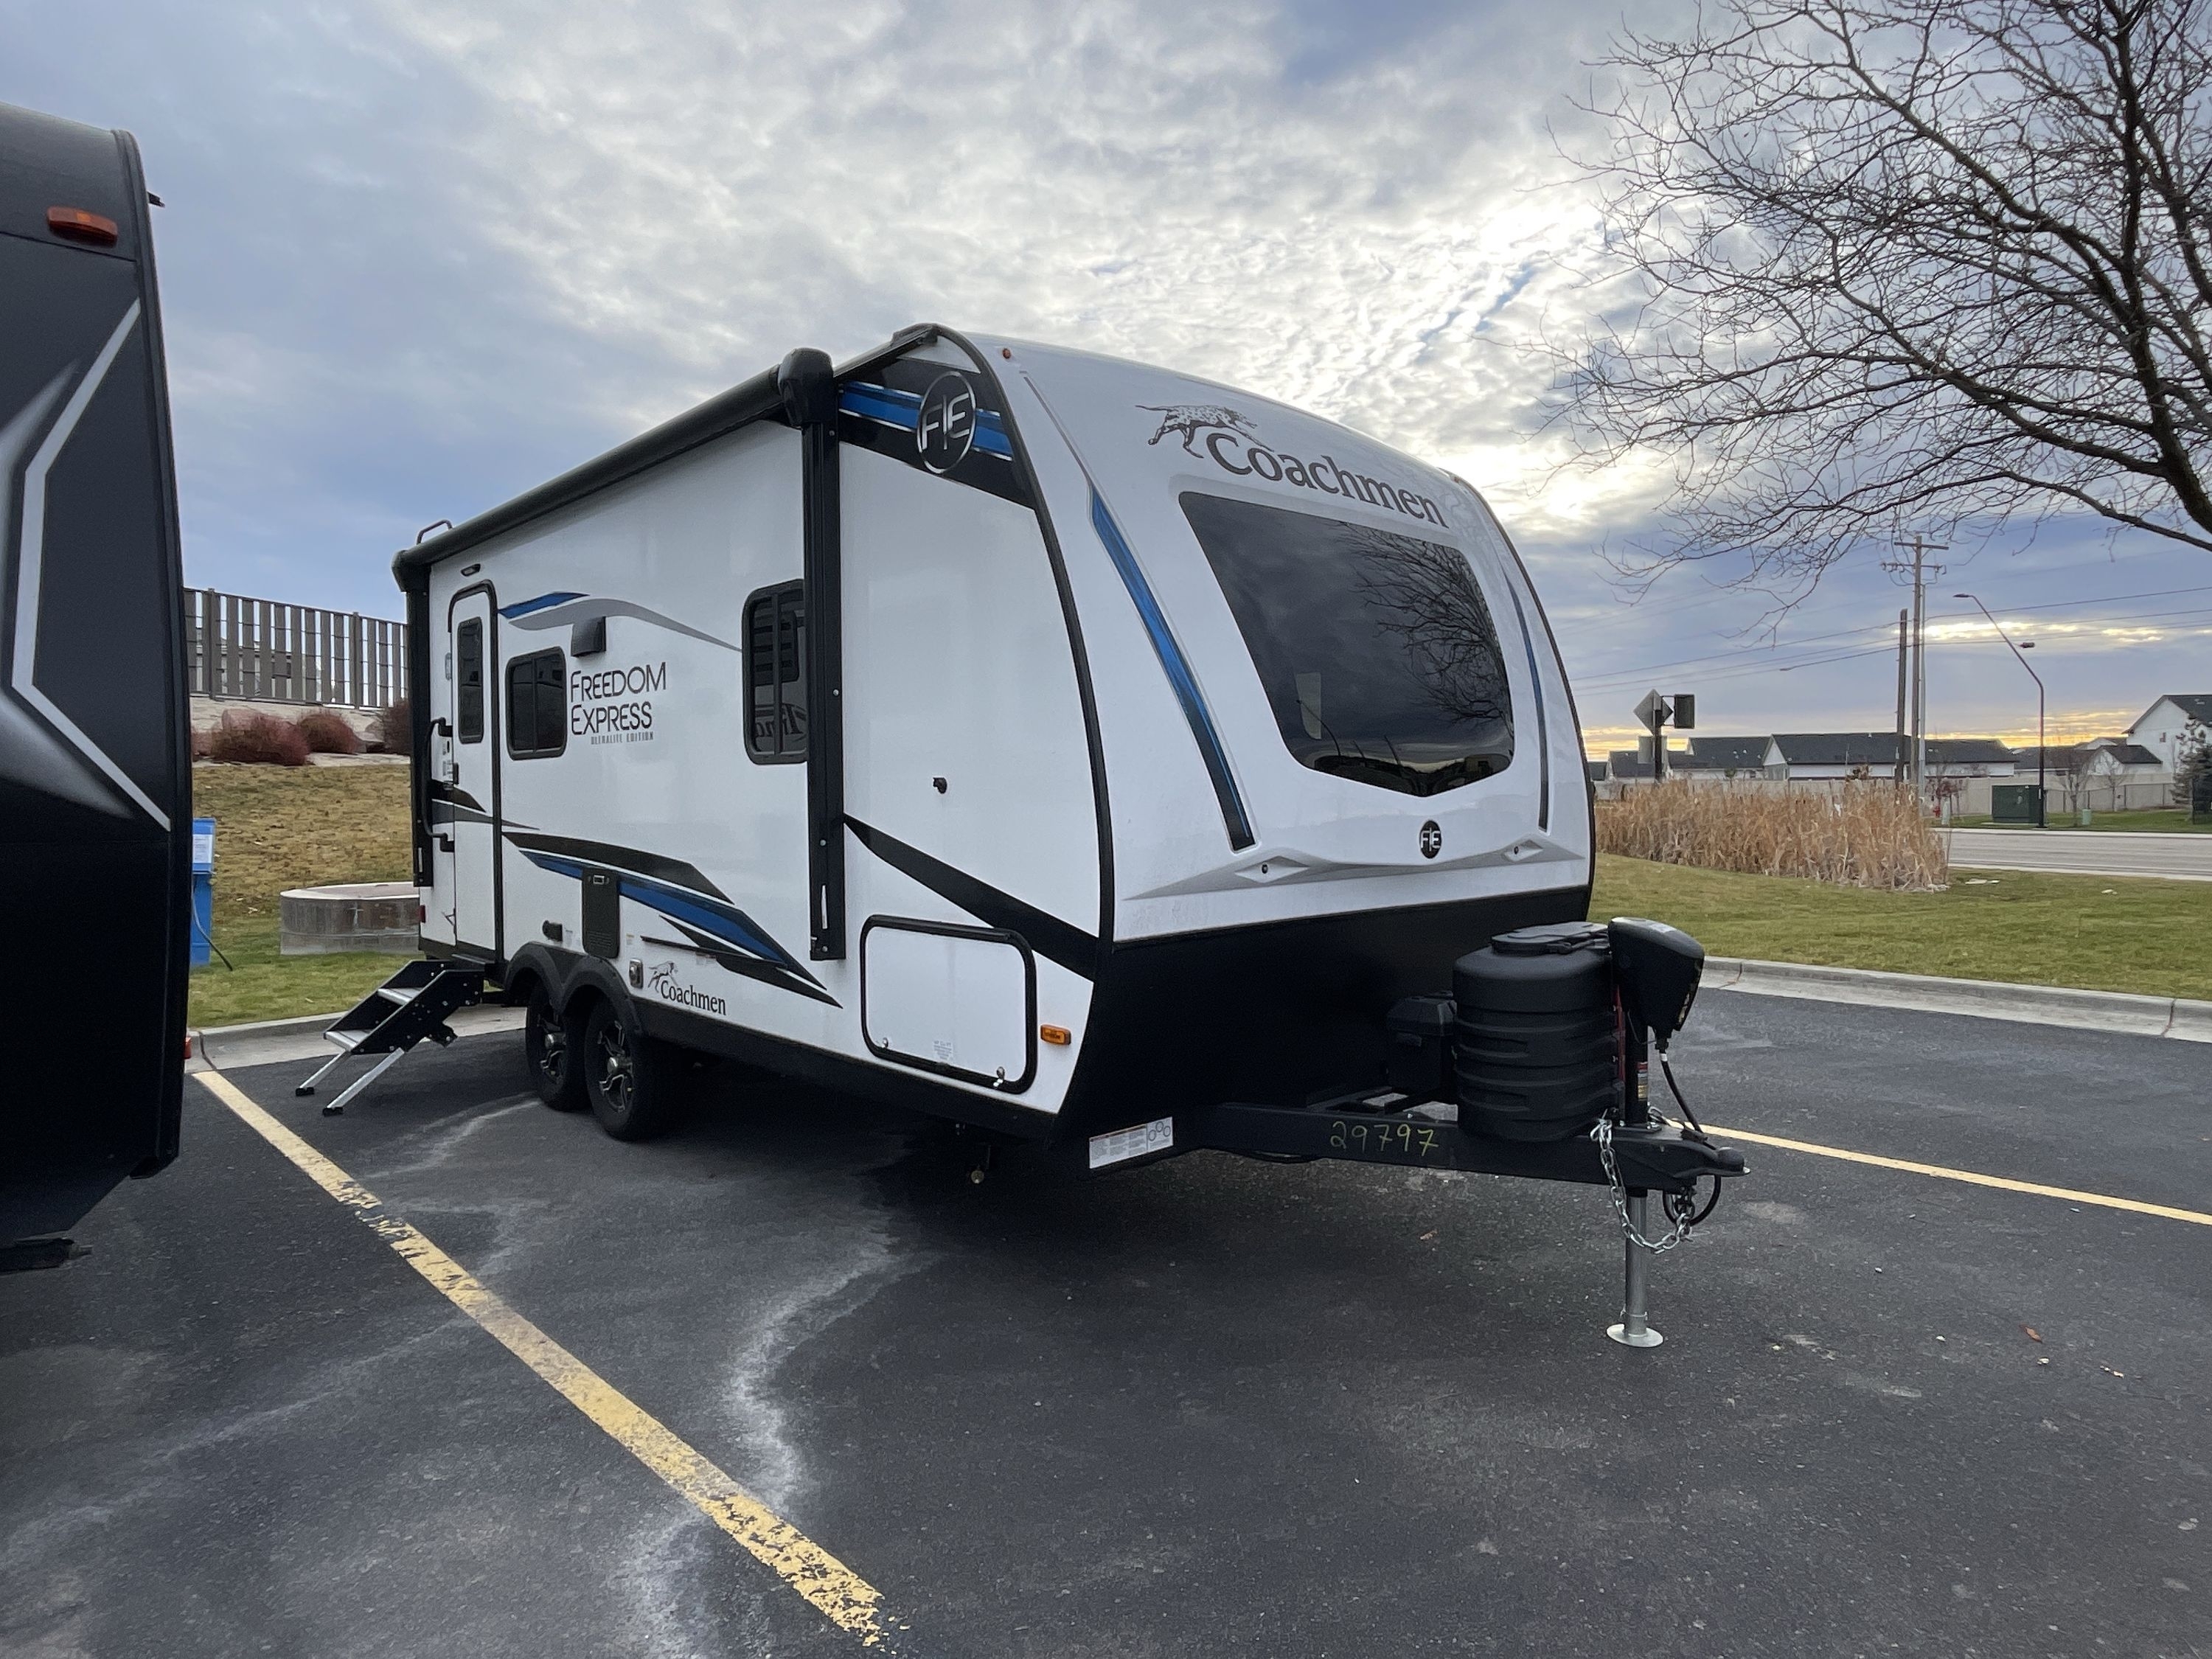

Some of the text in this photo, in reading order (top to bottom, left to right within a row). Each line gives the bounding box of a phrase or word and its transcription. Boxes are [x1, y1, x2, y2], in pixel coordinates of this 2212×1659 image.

[1206, 433, 1450, 529] Coachmen
[571, 661, 666, 703] FREEDOM
[571, 701, 653, 735] EXPRESS
[661, 980, 727, 1016] Coachmen
[1330, 1121, 1439, 1157] 29797
